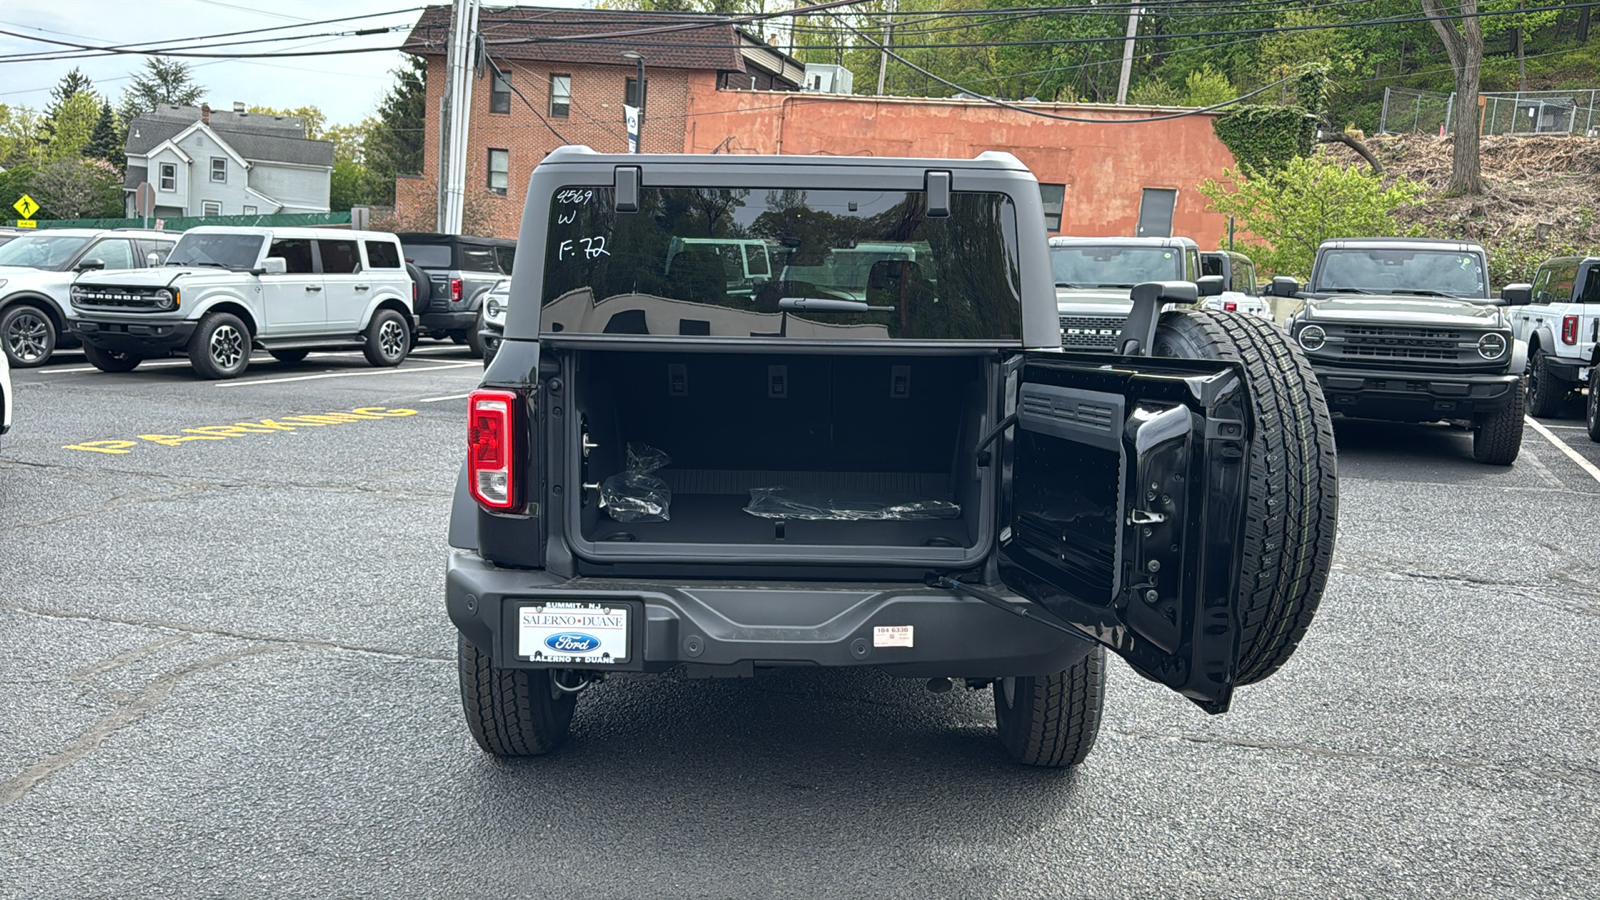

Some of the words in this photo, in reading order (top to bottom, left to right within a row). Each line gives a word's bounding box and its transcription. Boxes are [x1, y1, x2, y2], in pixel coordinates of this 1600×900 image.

[557, 189, 593, 206] 4569
[87, 293, 141, 301] BRONCO
[1060, 328, 1122, 336] ONC
[61, 406, 418, 455] PARKING
[588, 602, 601, 610] NJ
[523, 615, 576, 626] SALERNO
[582, 616, 623, 627] DUANE
[555, 634, 590, 650] Ford
